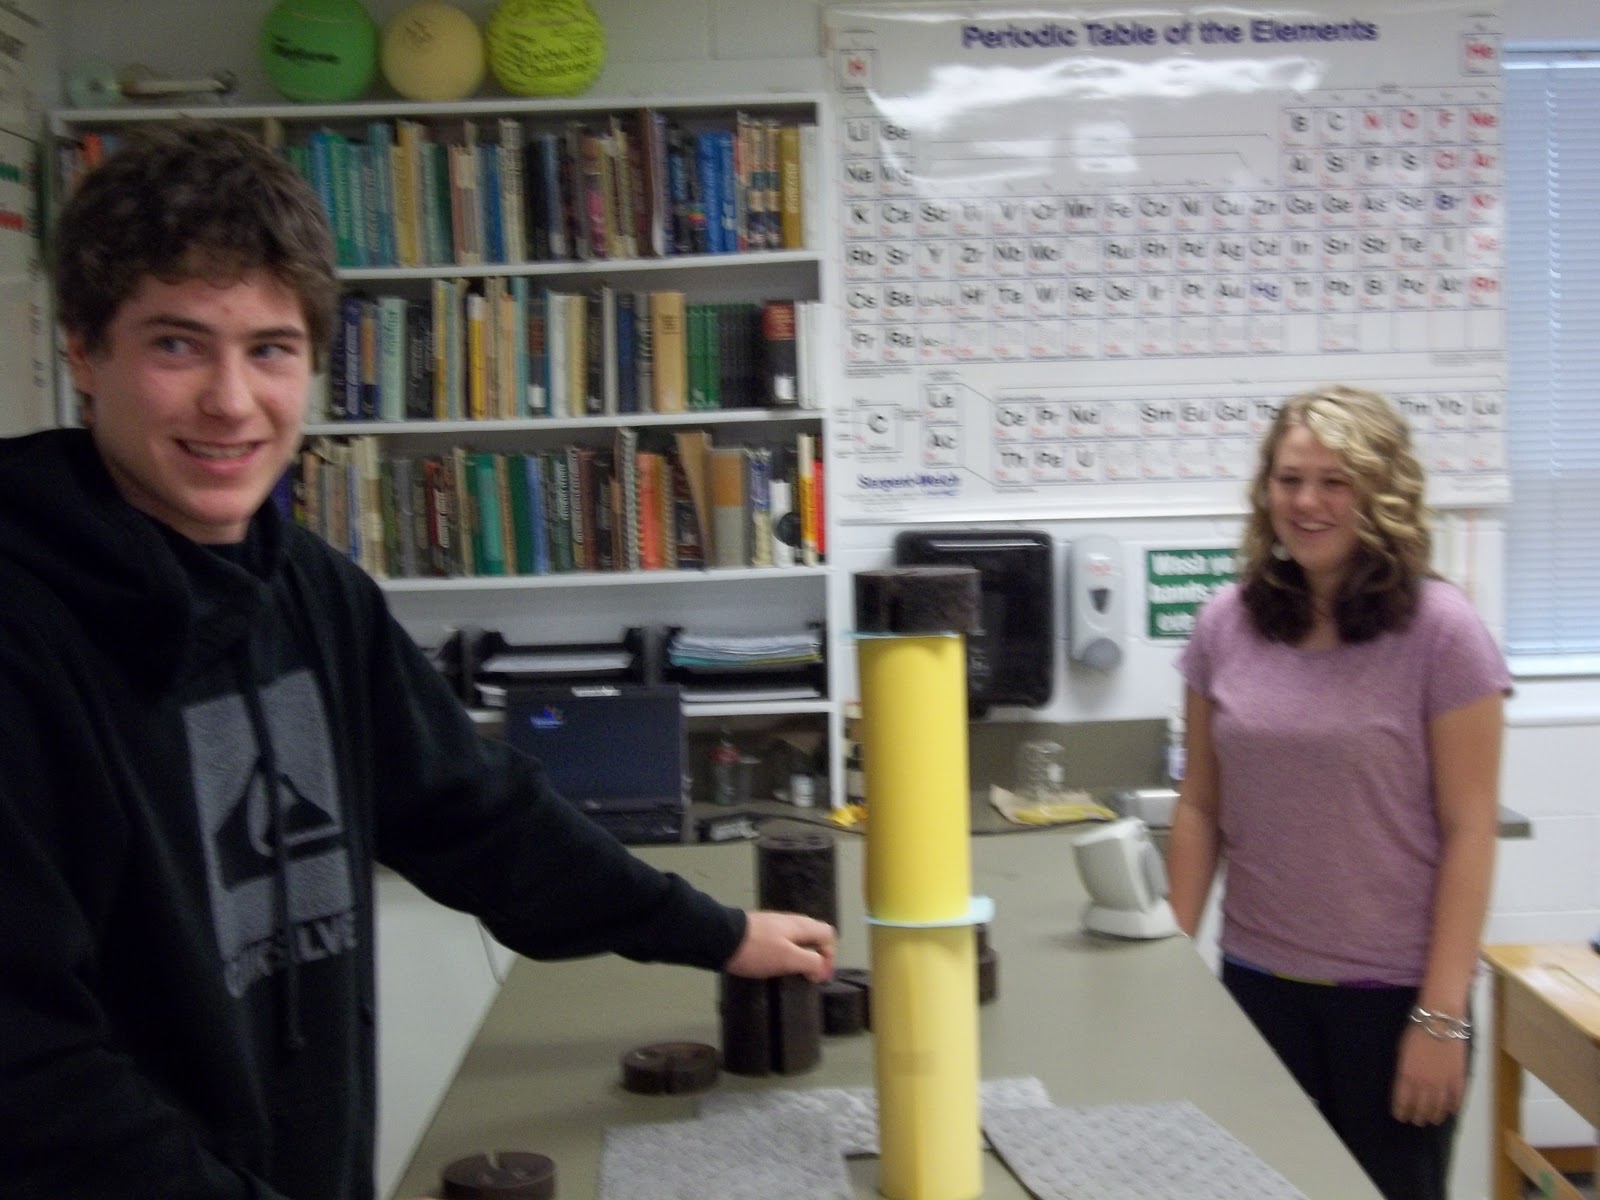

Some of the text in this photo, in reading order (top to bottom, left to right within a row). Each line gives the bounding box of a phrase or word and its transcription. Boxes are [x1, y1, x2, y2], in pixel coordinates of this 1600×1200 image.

[962, 18, 1380, 48] Periodic Table of the Elements
[1327, 112, 1345, 131] C
